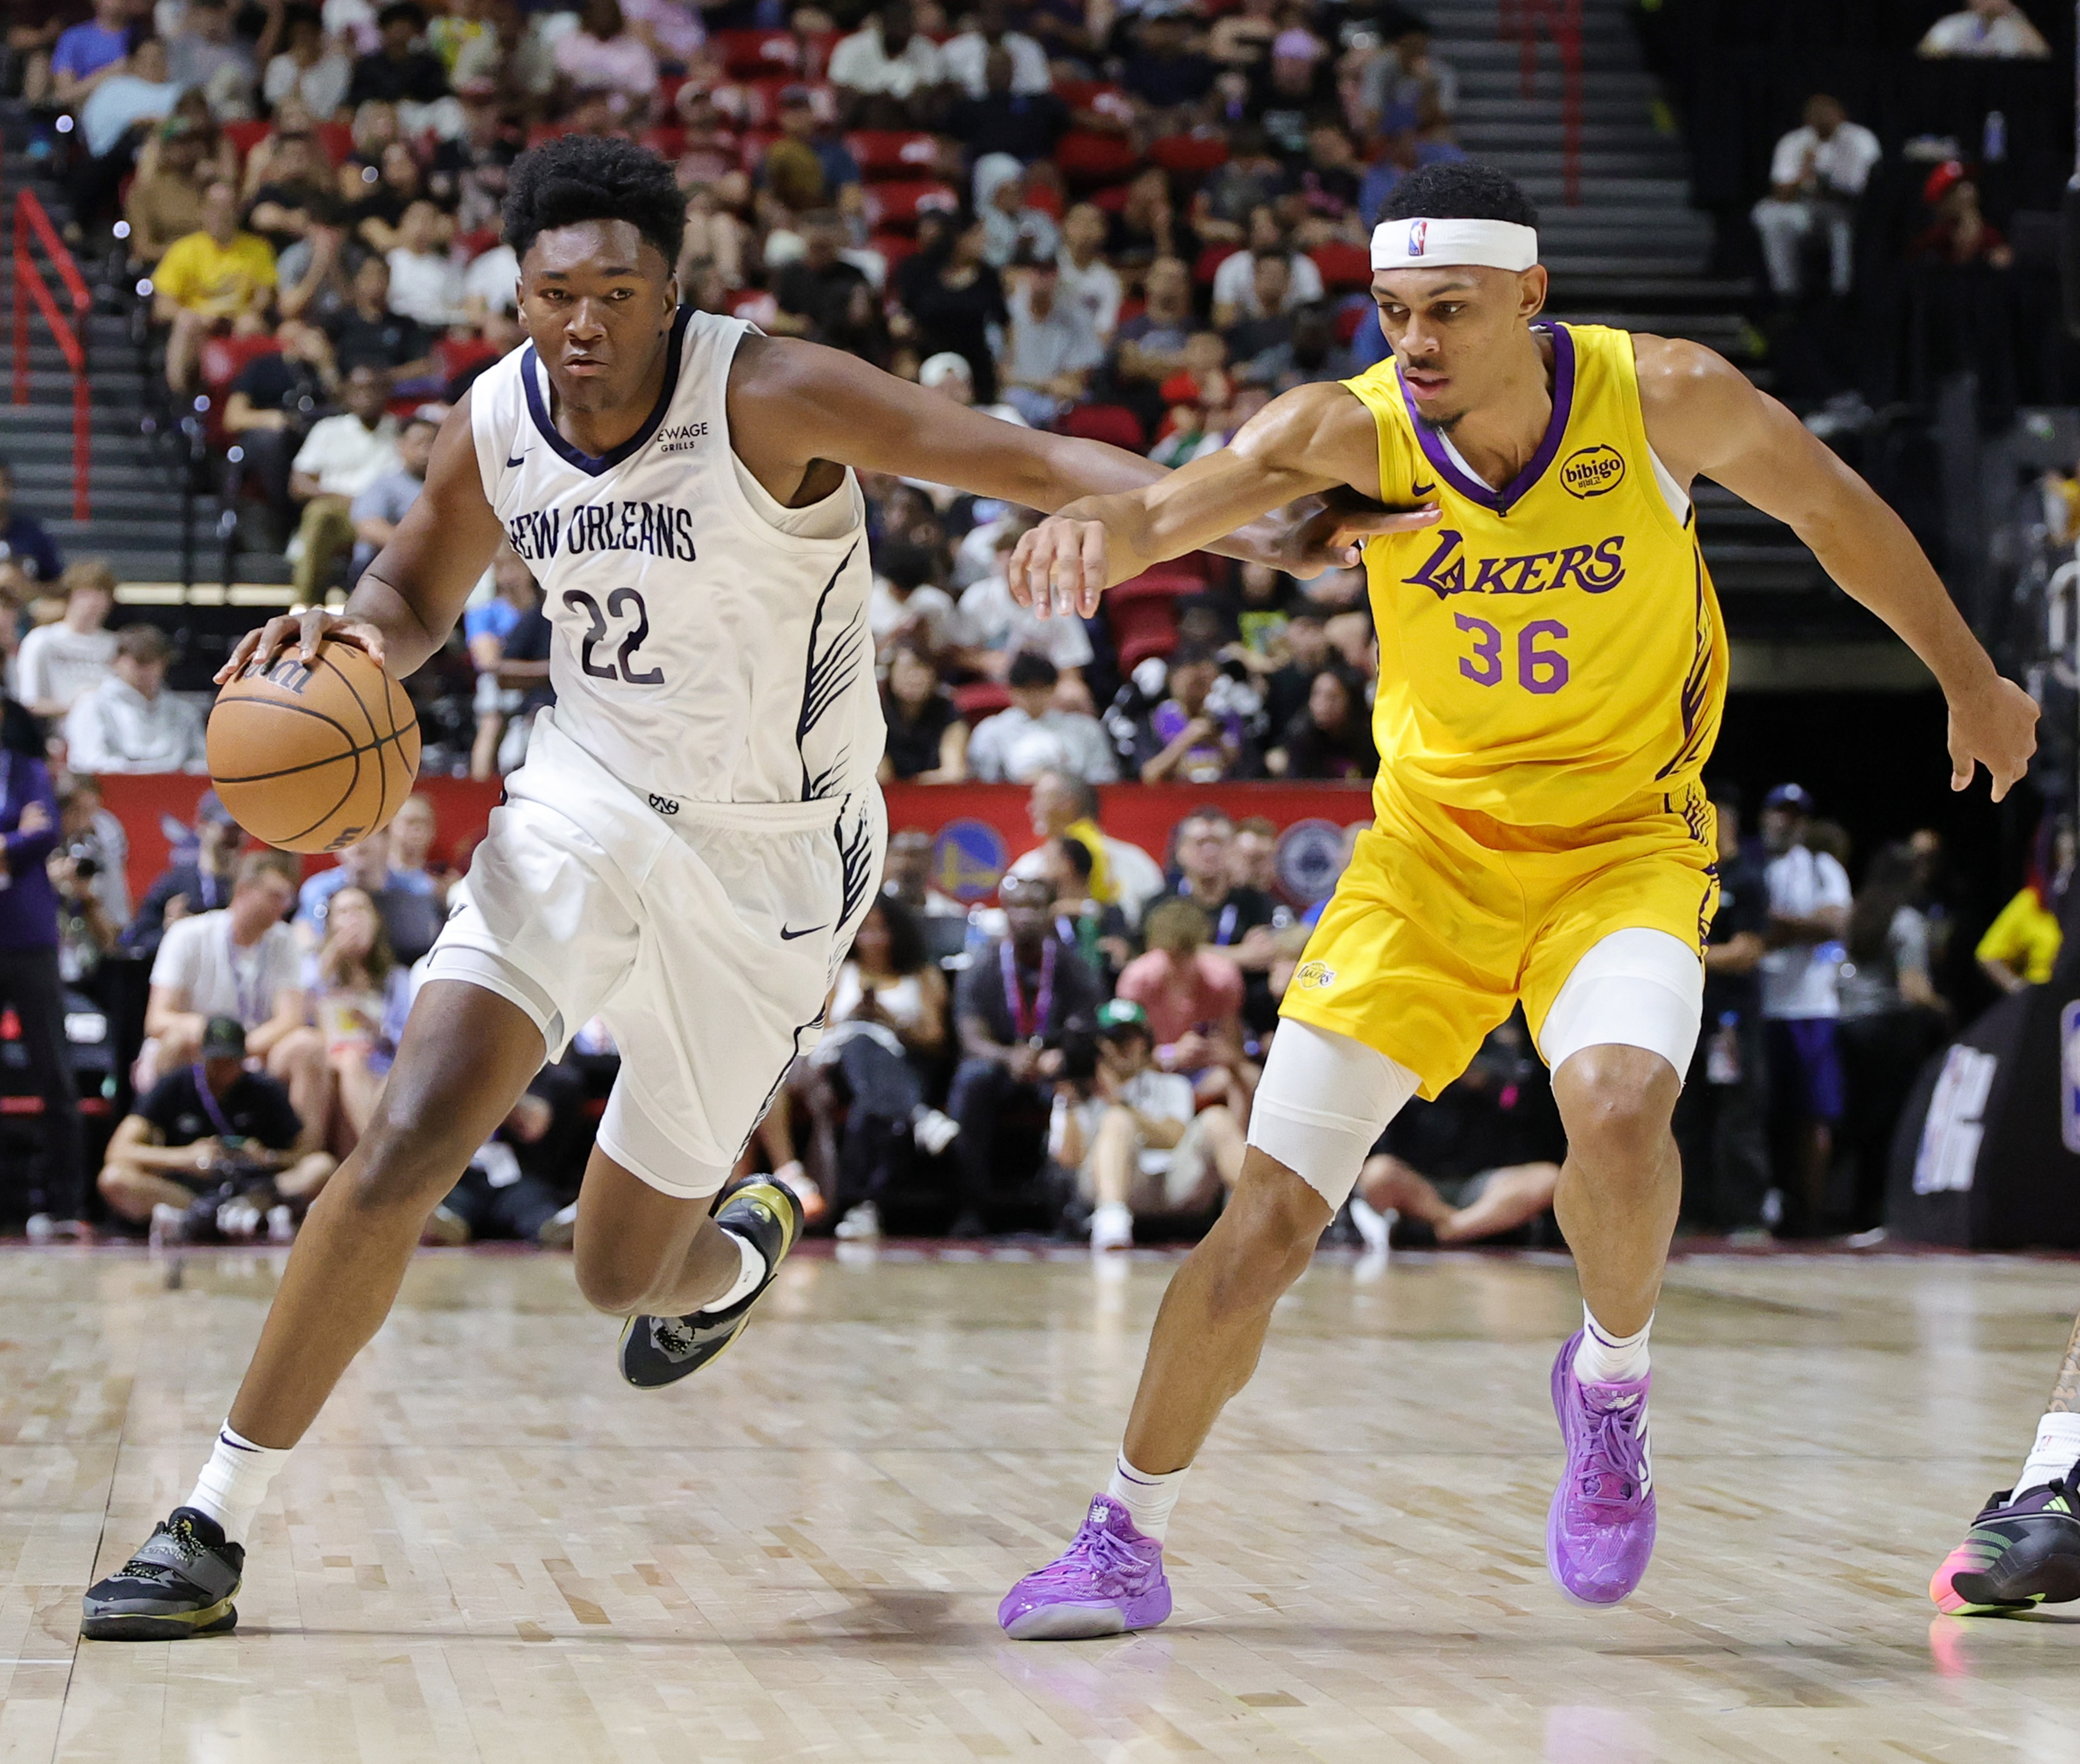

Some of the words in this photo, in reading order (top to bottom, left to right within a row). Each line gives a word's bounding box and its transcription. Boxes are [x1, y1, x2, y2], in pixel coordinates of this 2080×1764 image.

[661, 441, 695, 452] GRILLS
[1565, 458, 1621, 482] bibigo
[568, 502, 696, 562] ORLEANS
[1401, 529, 1625, 601] LAKERS
[563, 588, 664, 684] 22
[1454, 611, 1569, 694] 36
